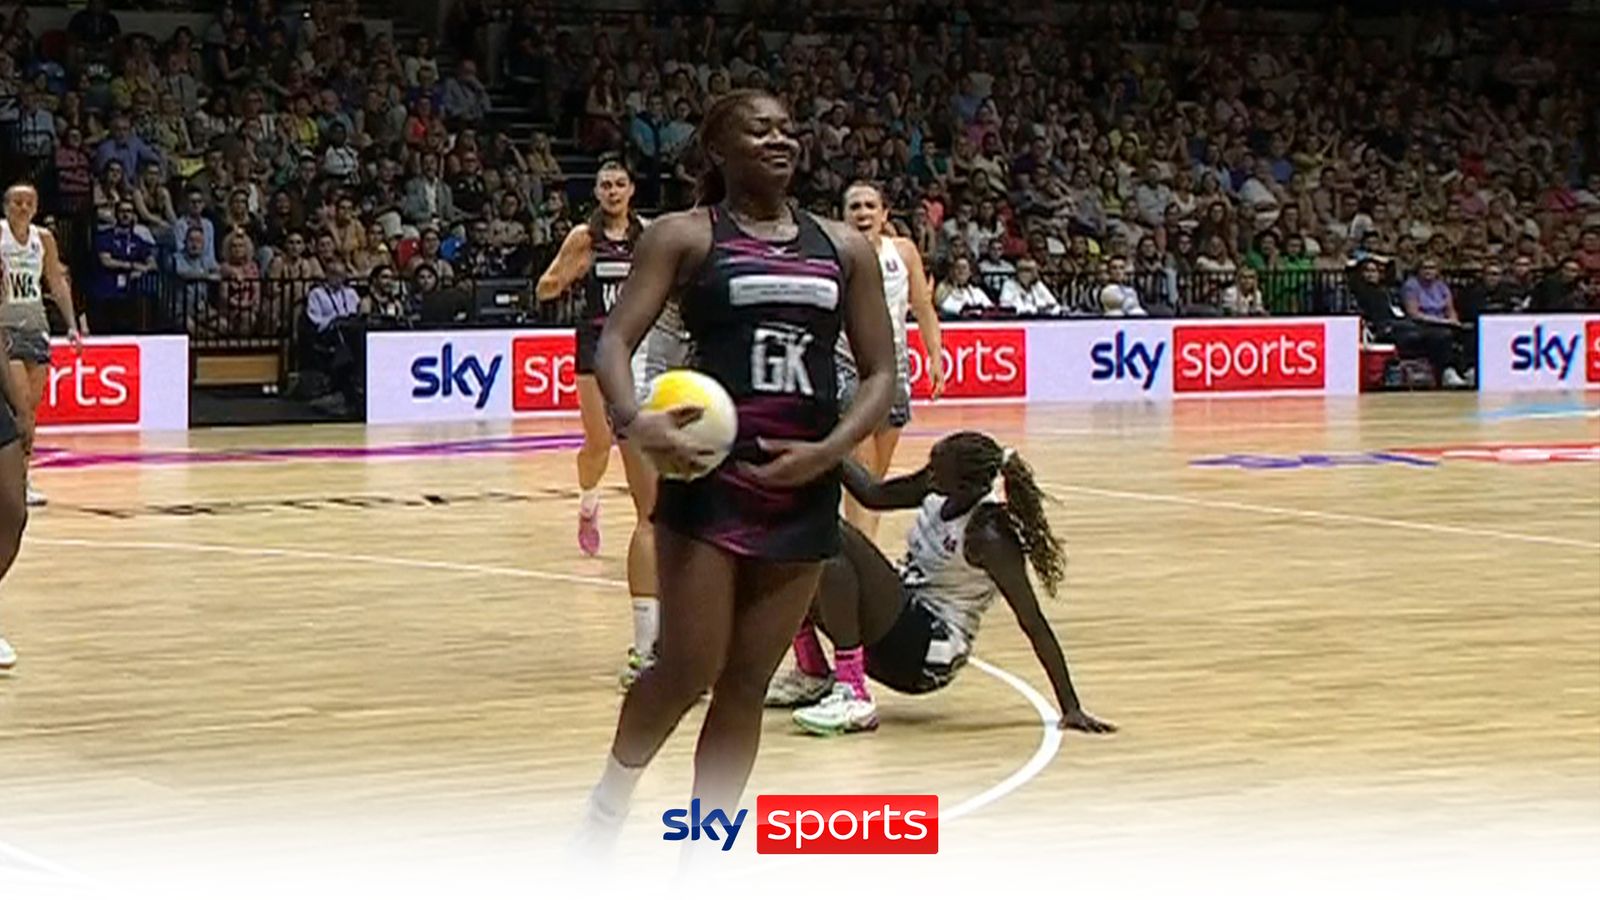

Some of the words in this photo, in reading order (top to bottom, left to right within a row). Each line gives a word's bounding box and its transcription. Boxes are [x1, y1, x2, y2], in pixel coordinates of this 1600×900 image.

[411, 342, 503, 409] sky
[752, 328, 814, 395] GK
[1088, 330, 1165, 390] sky
[1181, 335, 1318, 386] sports
[1510, 324, 1580, 380] sky
[49, 358, 127, 407] rts
